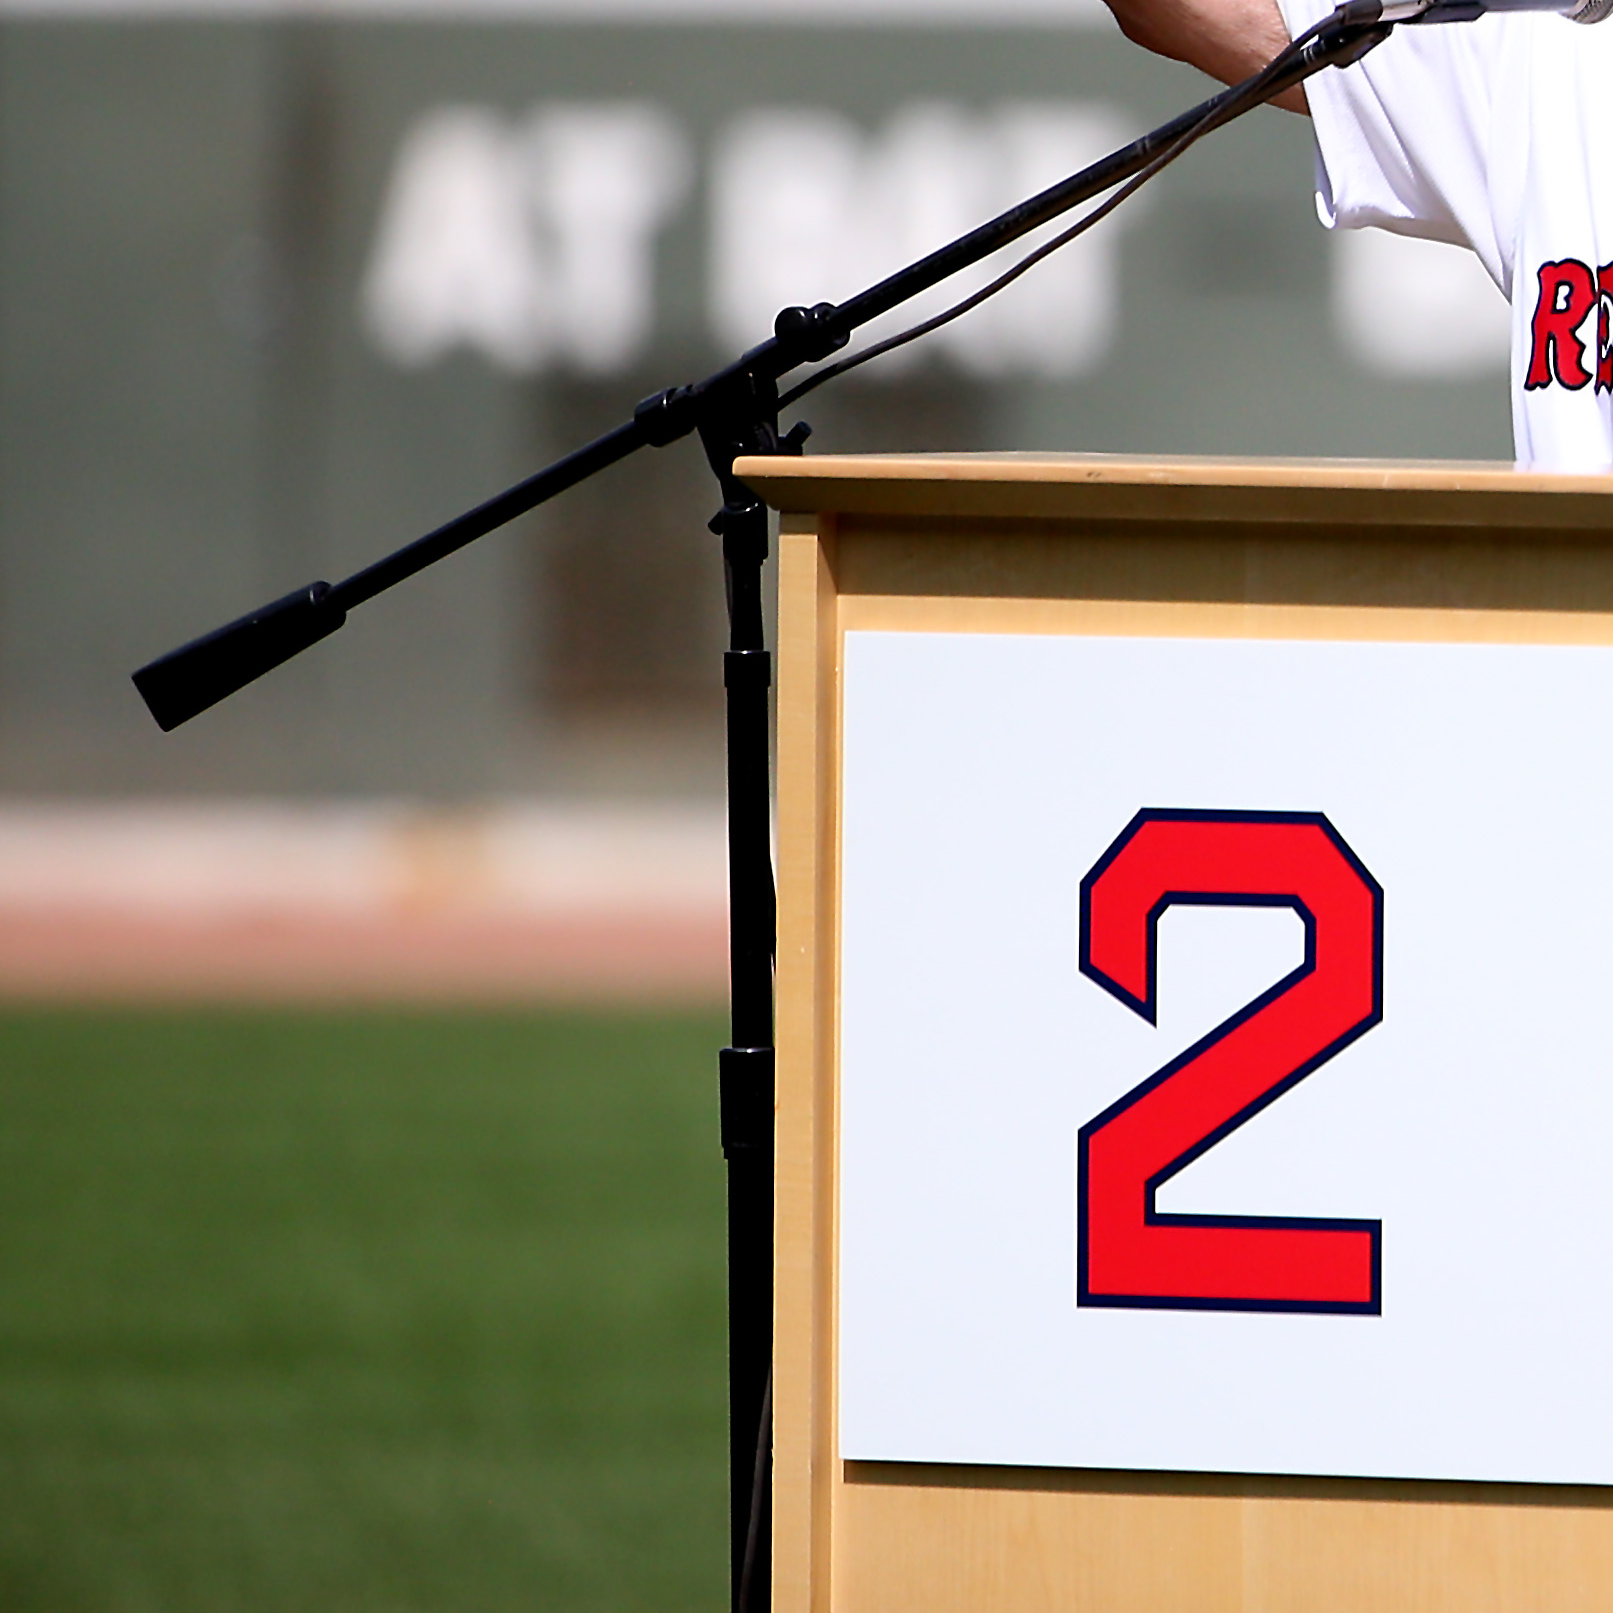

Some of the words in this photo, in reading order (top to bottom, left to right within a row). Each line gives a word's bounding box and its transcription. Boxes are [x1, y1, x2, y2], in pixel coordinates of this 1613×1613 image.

[362, 97, 692, 371] AT
[704, 98, 1122, 381] BAT
[1077, 808, 1384, 1316] 2
